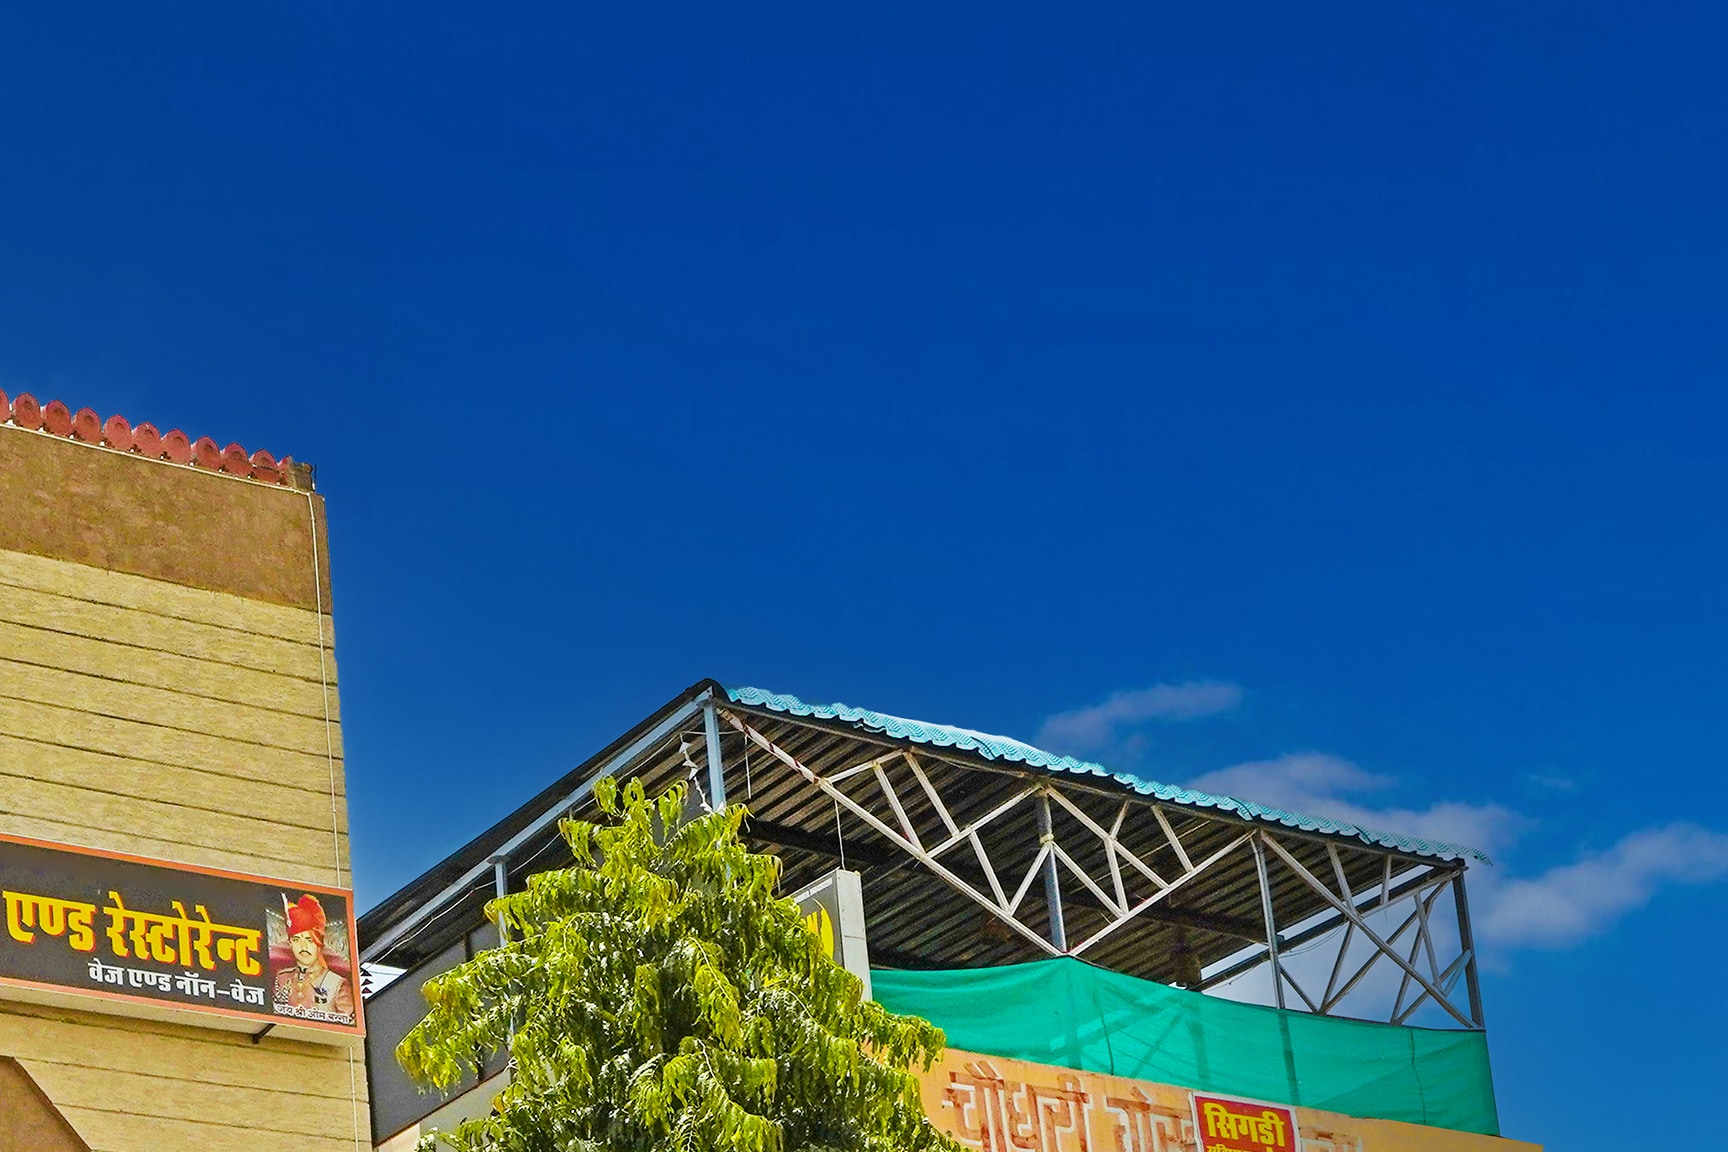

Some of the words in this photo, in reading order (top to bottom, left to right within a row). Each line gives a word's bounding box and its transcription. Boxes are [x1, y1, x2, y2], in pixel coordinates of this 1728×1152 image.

[2, 890, 98, 953] एण्ड
[103, 891, 264, 977] रेस्टोरेन्ट
[87, 957, 125, 985] वेज
[127, 968, 172, 992] एण्ड
